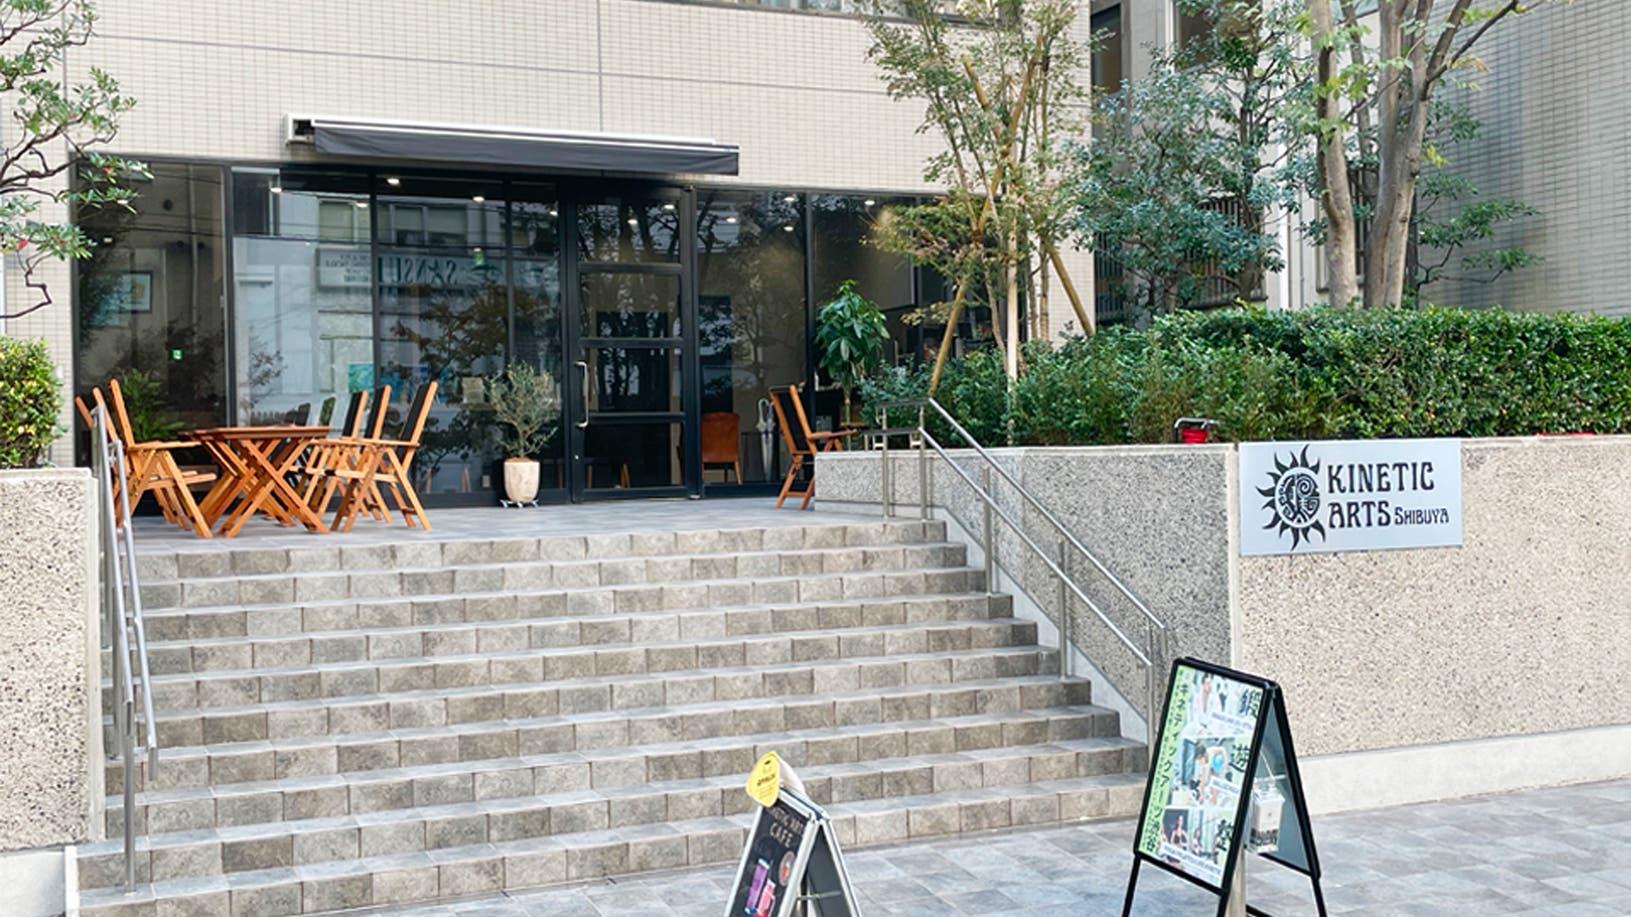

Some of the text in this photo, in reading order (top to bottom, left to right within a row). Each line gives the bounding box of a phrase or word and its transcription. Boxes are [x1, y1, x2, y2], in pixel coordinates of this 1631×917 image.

[1327, 462, 1435, 494] KINETIC
[1328, 500, 1392, 529] ARTS
[1146, 684, 1188, 852] キネティックアーツ渋谷
[771, 822, 793, 847] CAFE
